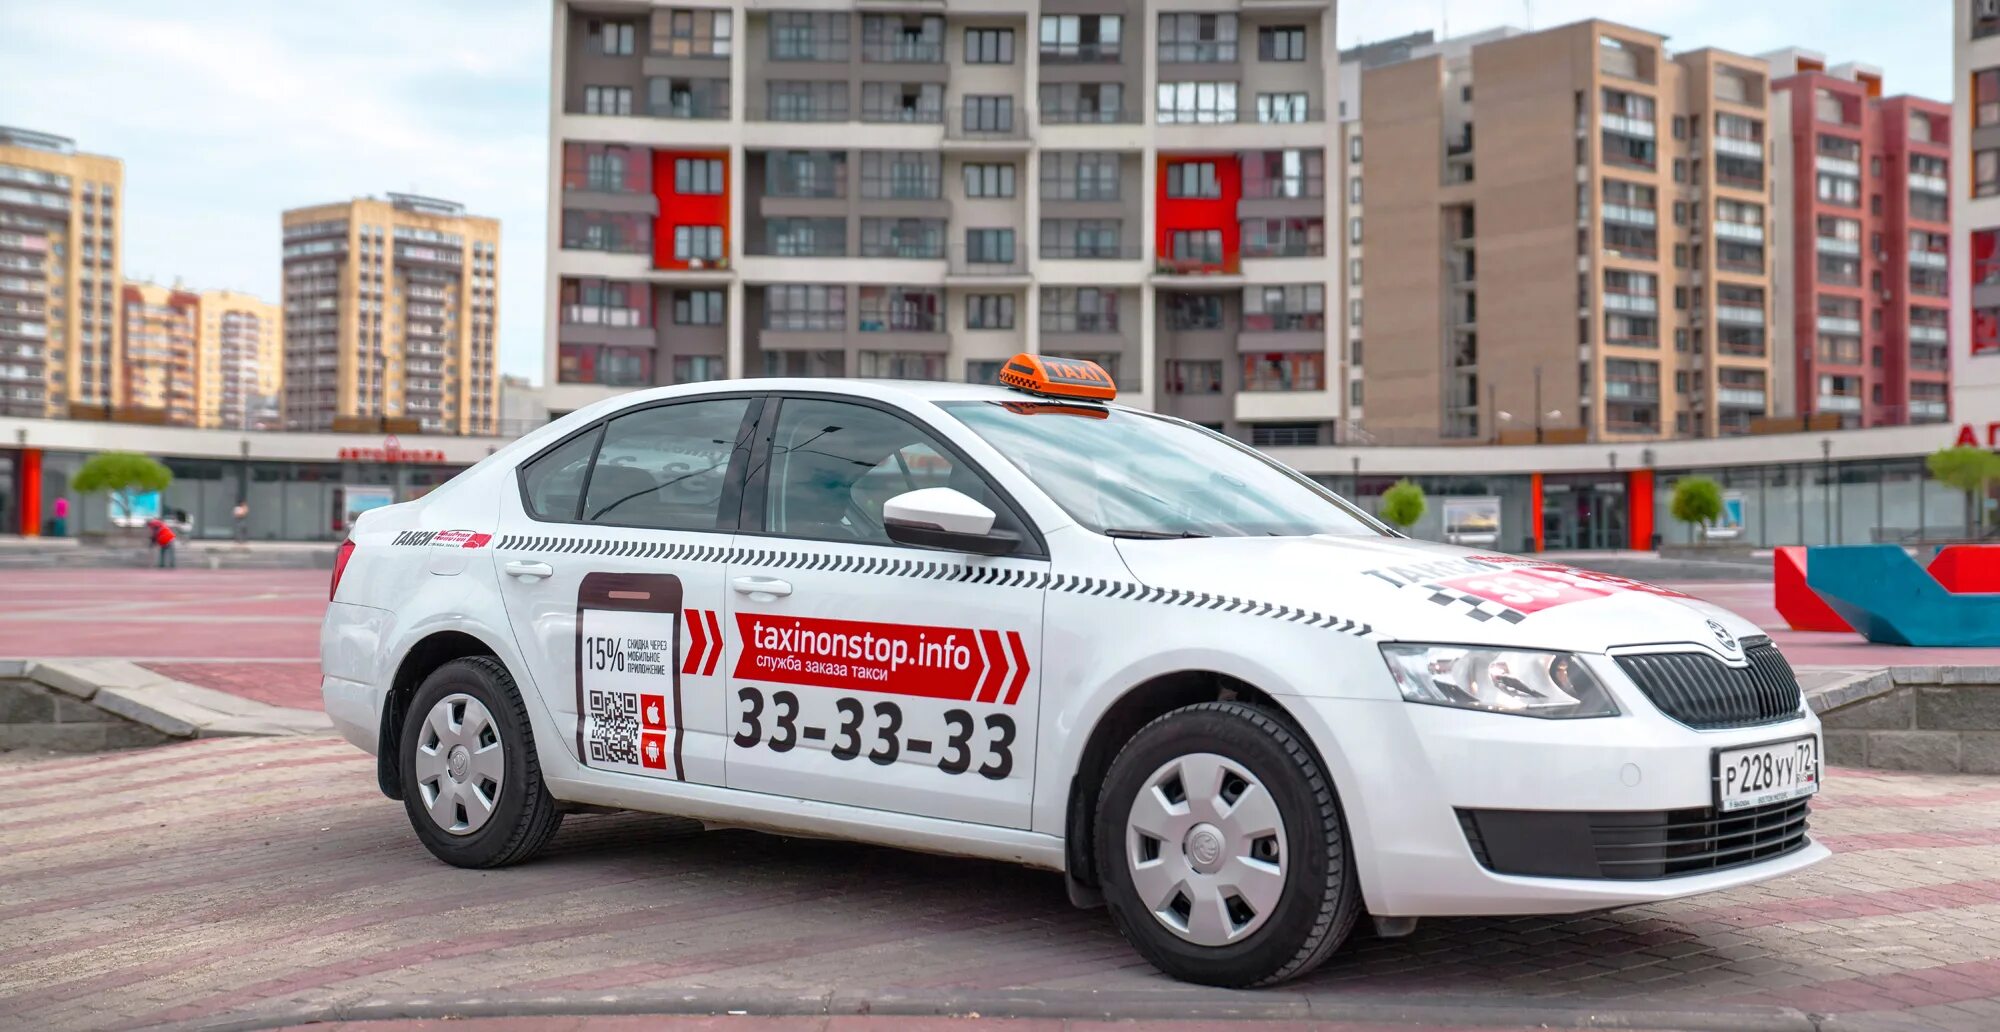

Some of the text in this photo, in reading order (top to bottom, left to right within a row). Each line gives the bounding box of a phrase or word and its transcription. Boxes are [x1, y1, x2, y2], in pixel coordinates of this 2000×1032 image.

[1045, 361, 1102, 382] TAXI
[391, 531, 438, 546] ТАКСИ
[586, 636, 625, 672] 15%
[627, 638, 668, 651] СКИДКА ЧЕРЕЗ
[627, 650, 661, 663] МОБИЛЬНОЕ
[753, 620, 971, 671] taxinonstop.info
[627, 662, 666, 675] ПРИЛОЖЕНИЕ
[756, 654, 888, 682] служба заказа такси
[733, 686, 1017, 780] 33-33-33
[1797, 744, 1811, 772] 72
